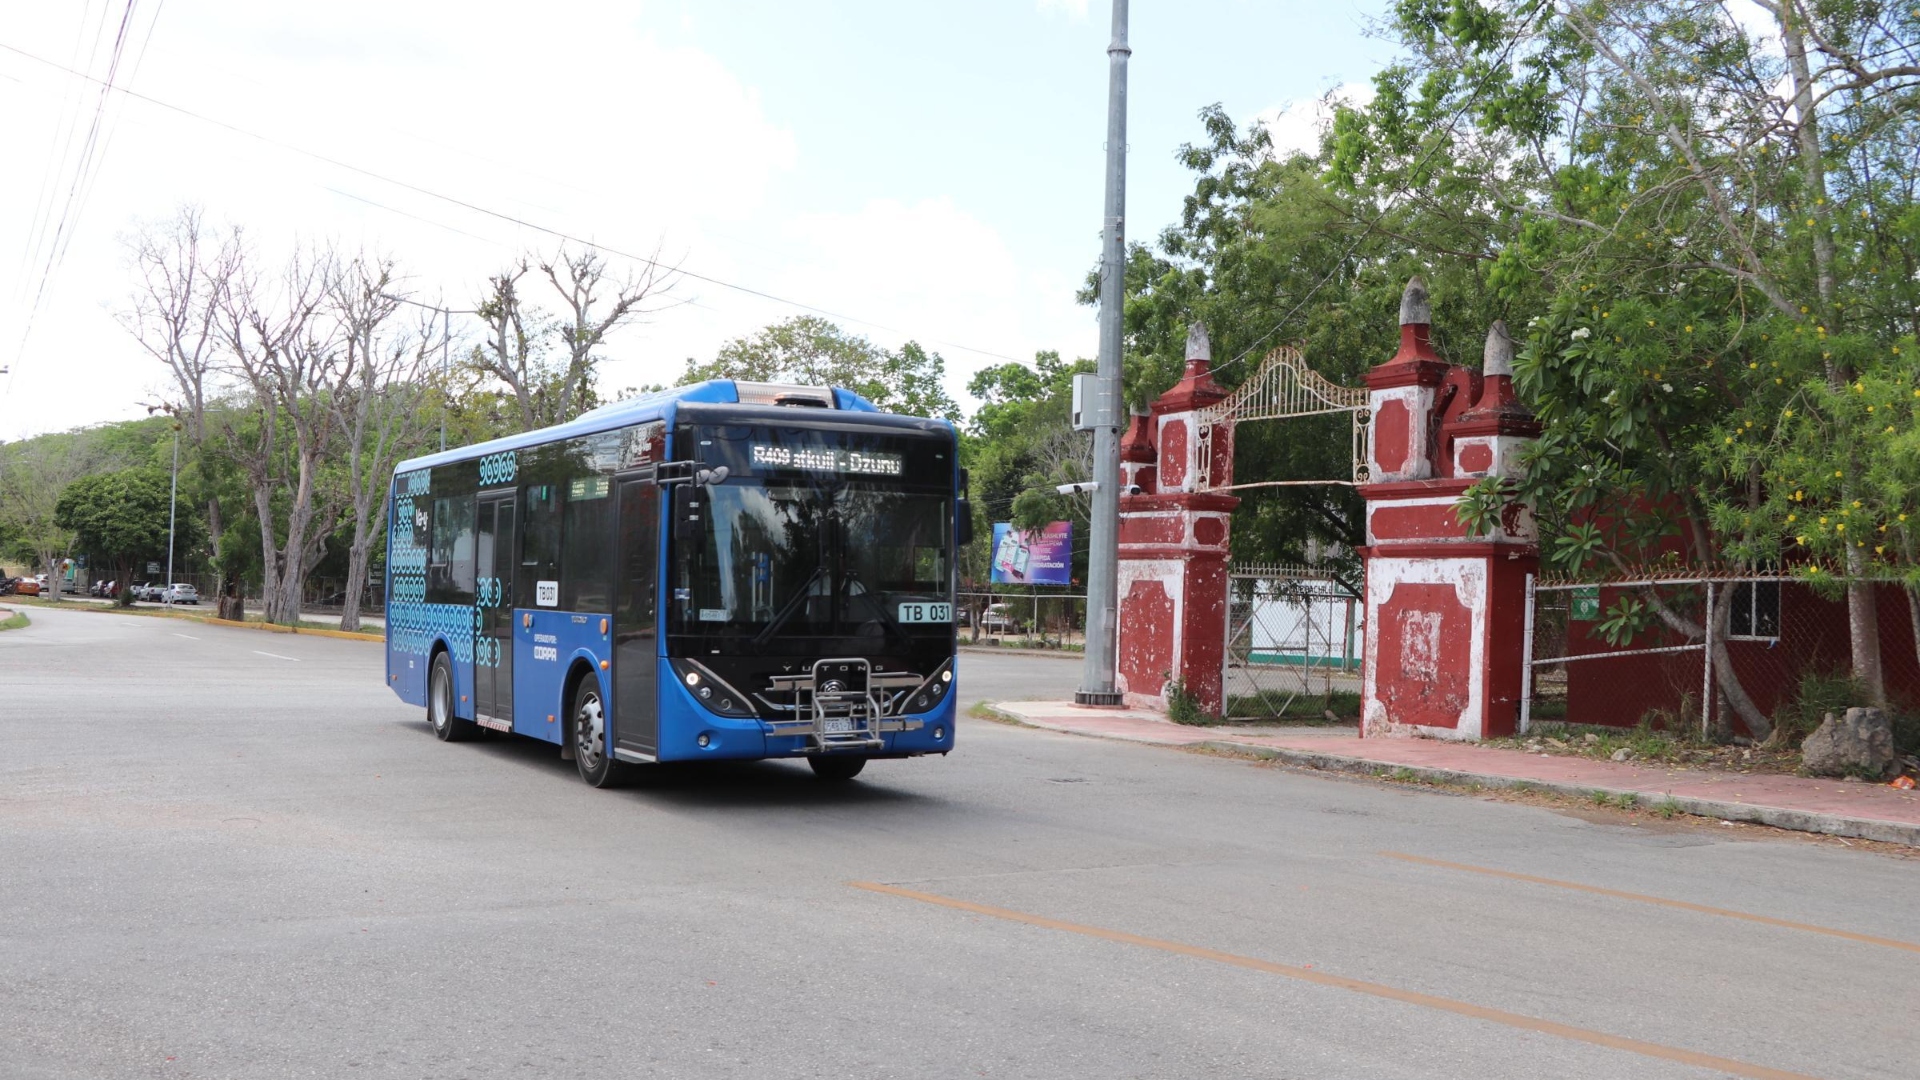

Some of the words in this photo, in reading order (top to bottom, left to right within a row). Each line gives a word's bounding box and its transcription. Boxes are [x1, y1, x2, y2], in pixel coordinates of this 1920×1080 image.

[754, 446, 790, 465] R409
[903, 605, 923, 621] TB
[930, 605, 949, 621] 031
